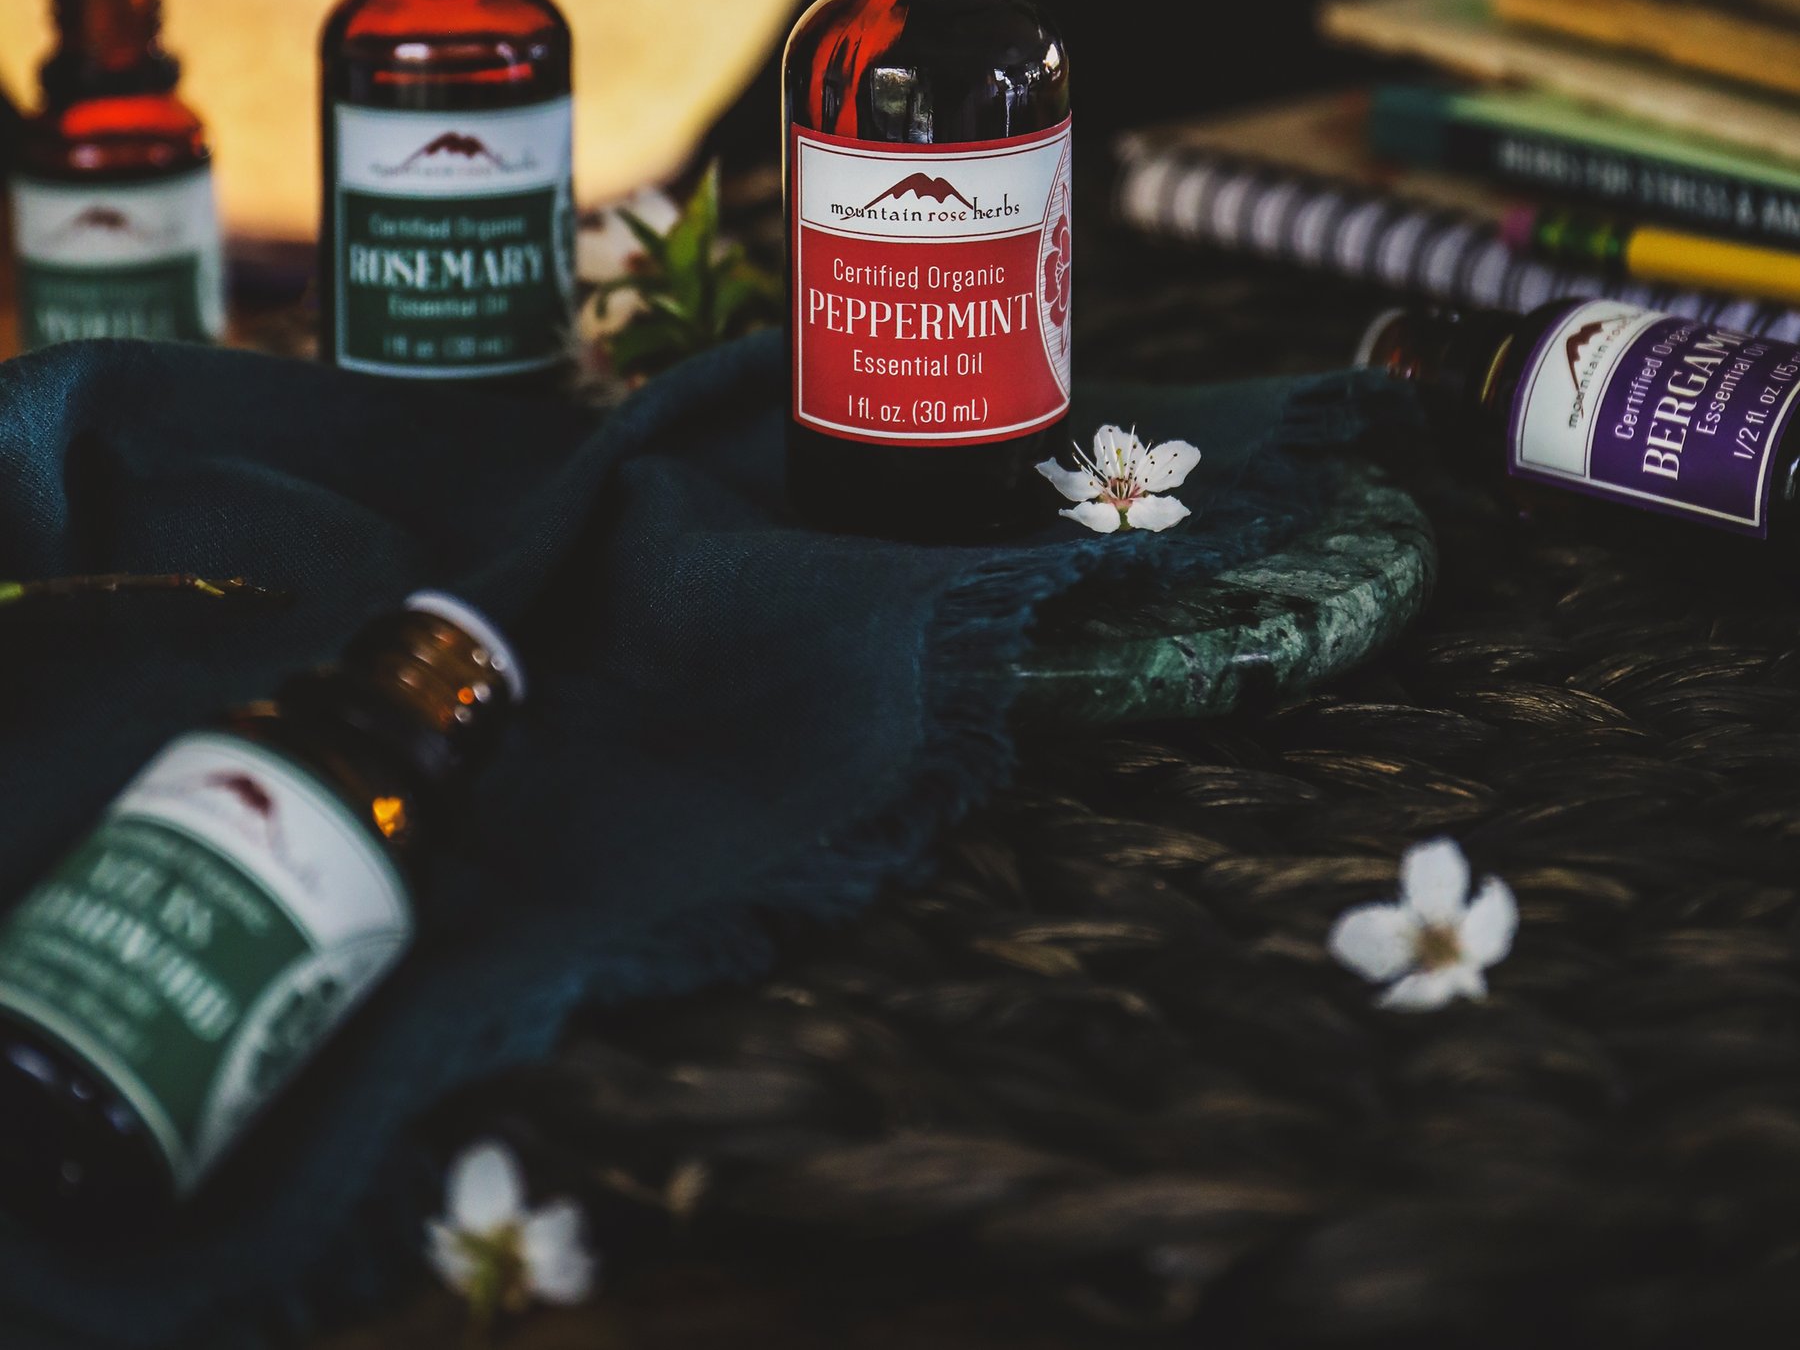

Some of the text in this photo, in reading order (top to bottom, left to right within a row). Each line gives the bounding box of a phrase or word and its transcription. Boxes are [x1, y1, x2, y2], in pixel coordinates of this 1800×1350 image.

[831, 193, 1020, 222] mountain rose herbs
[350, 243, 544, 290] ROSEMARY
[833, 257, 1005, 292] Certified Organic
[808, 287, 1033, 341] PEPPERMINT
[853, 349, 983, 377] Essential Oil
[880, 404, 906, 423] oz.
[912, 399, 946, 426] (30
[953, 396, 988, 423] mL)
[1614, 356, 1663, 440] Certified
[1696, 357, 1754, 437] Essential
[1733, 362, 1798, 459] 1/2 fl. oz. (15
